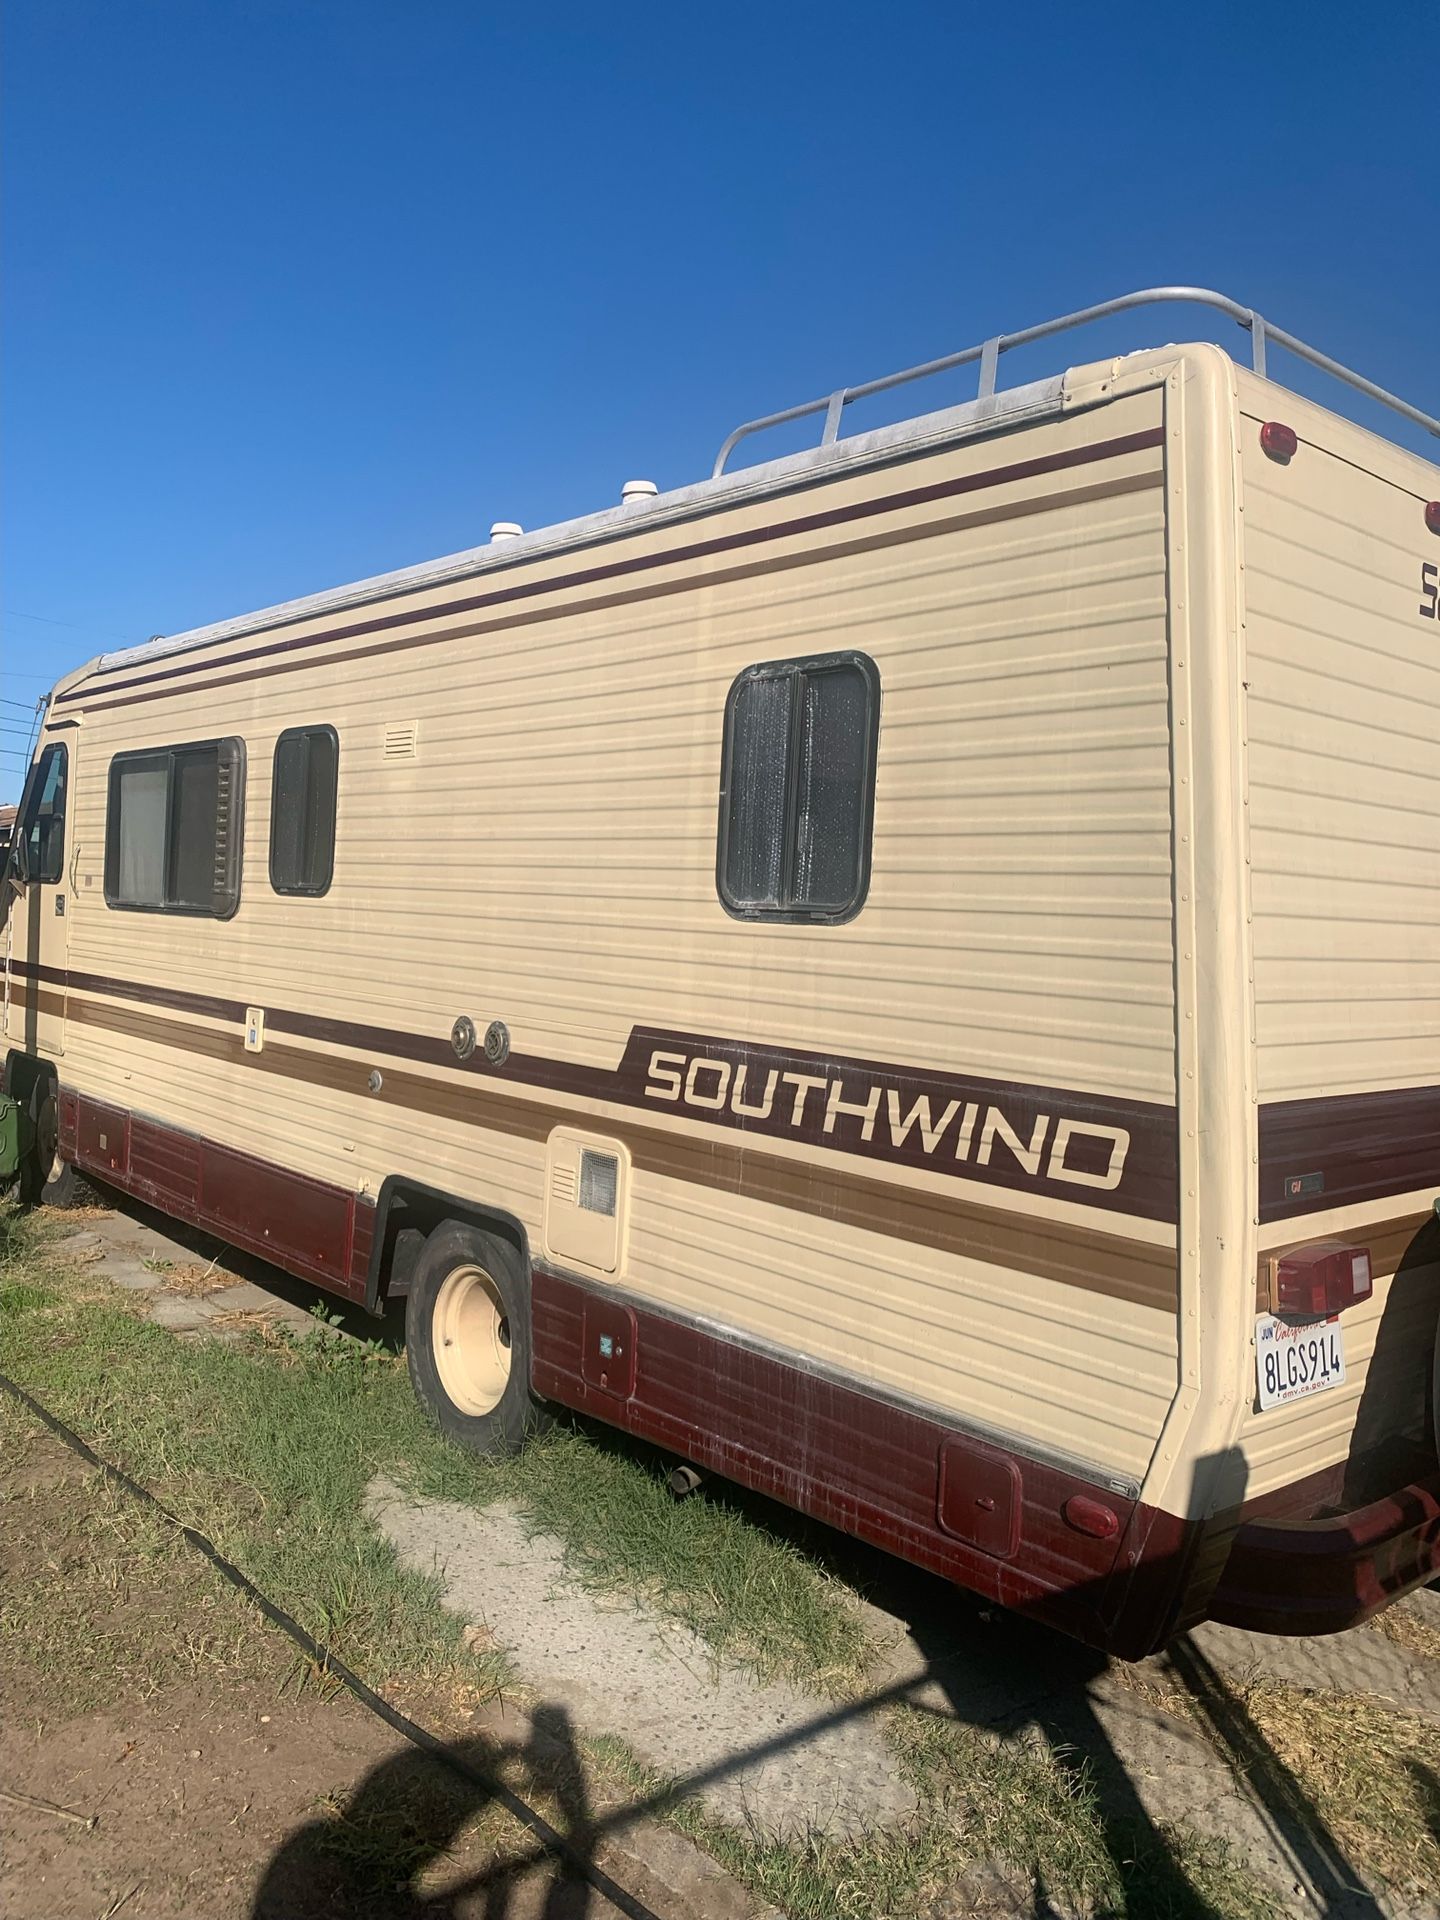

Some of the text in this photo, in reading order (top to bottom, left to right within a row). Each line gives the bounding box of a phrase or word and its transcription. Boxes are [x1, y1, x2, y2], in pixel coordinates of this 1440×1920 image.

[1419, 562, 1440, 621] S
[644, 1050, 1130, 1190] SOUTHWIND
[1261, 1327, 1274, 1341] JUN
[1265, 1334, 1340, 1394] 8LGS914
[1282, 1379, 1326, 1399] dmv.ca.gov
